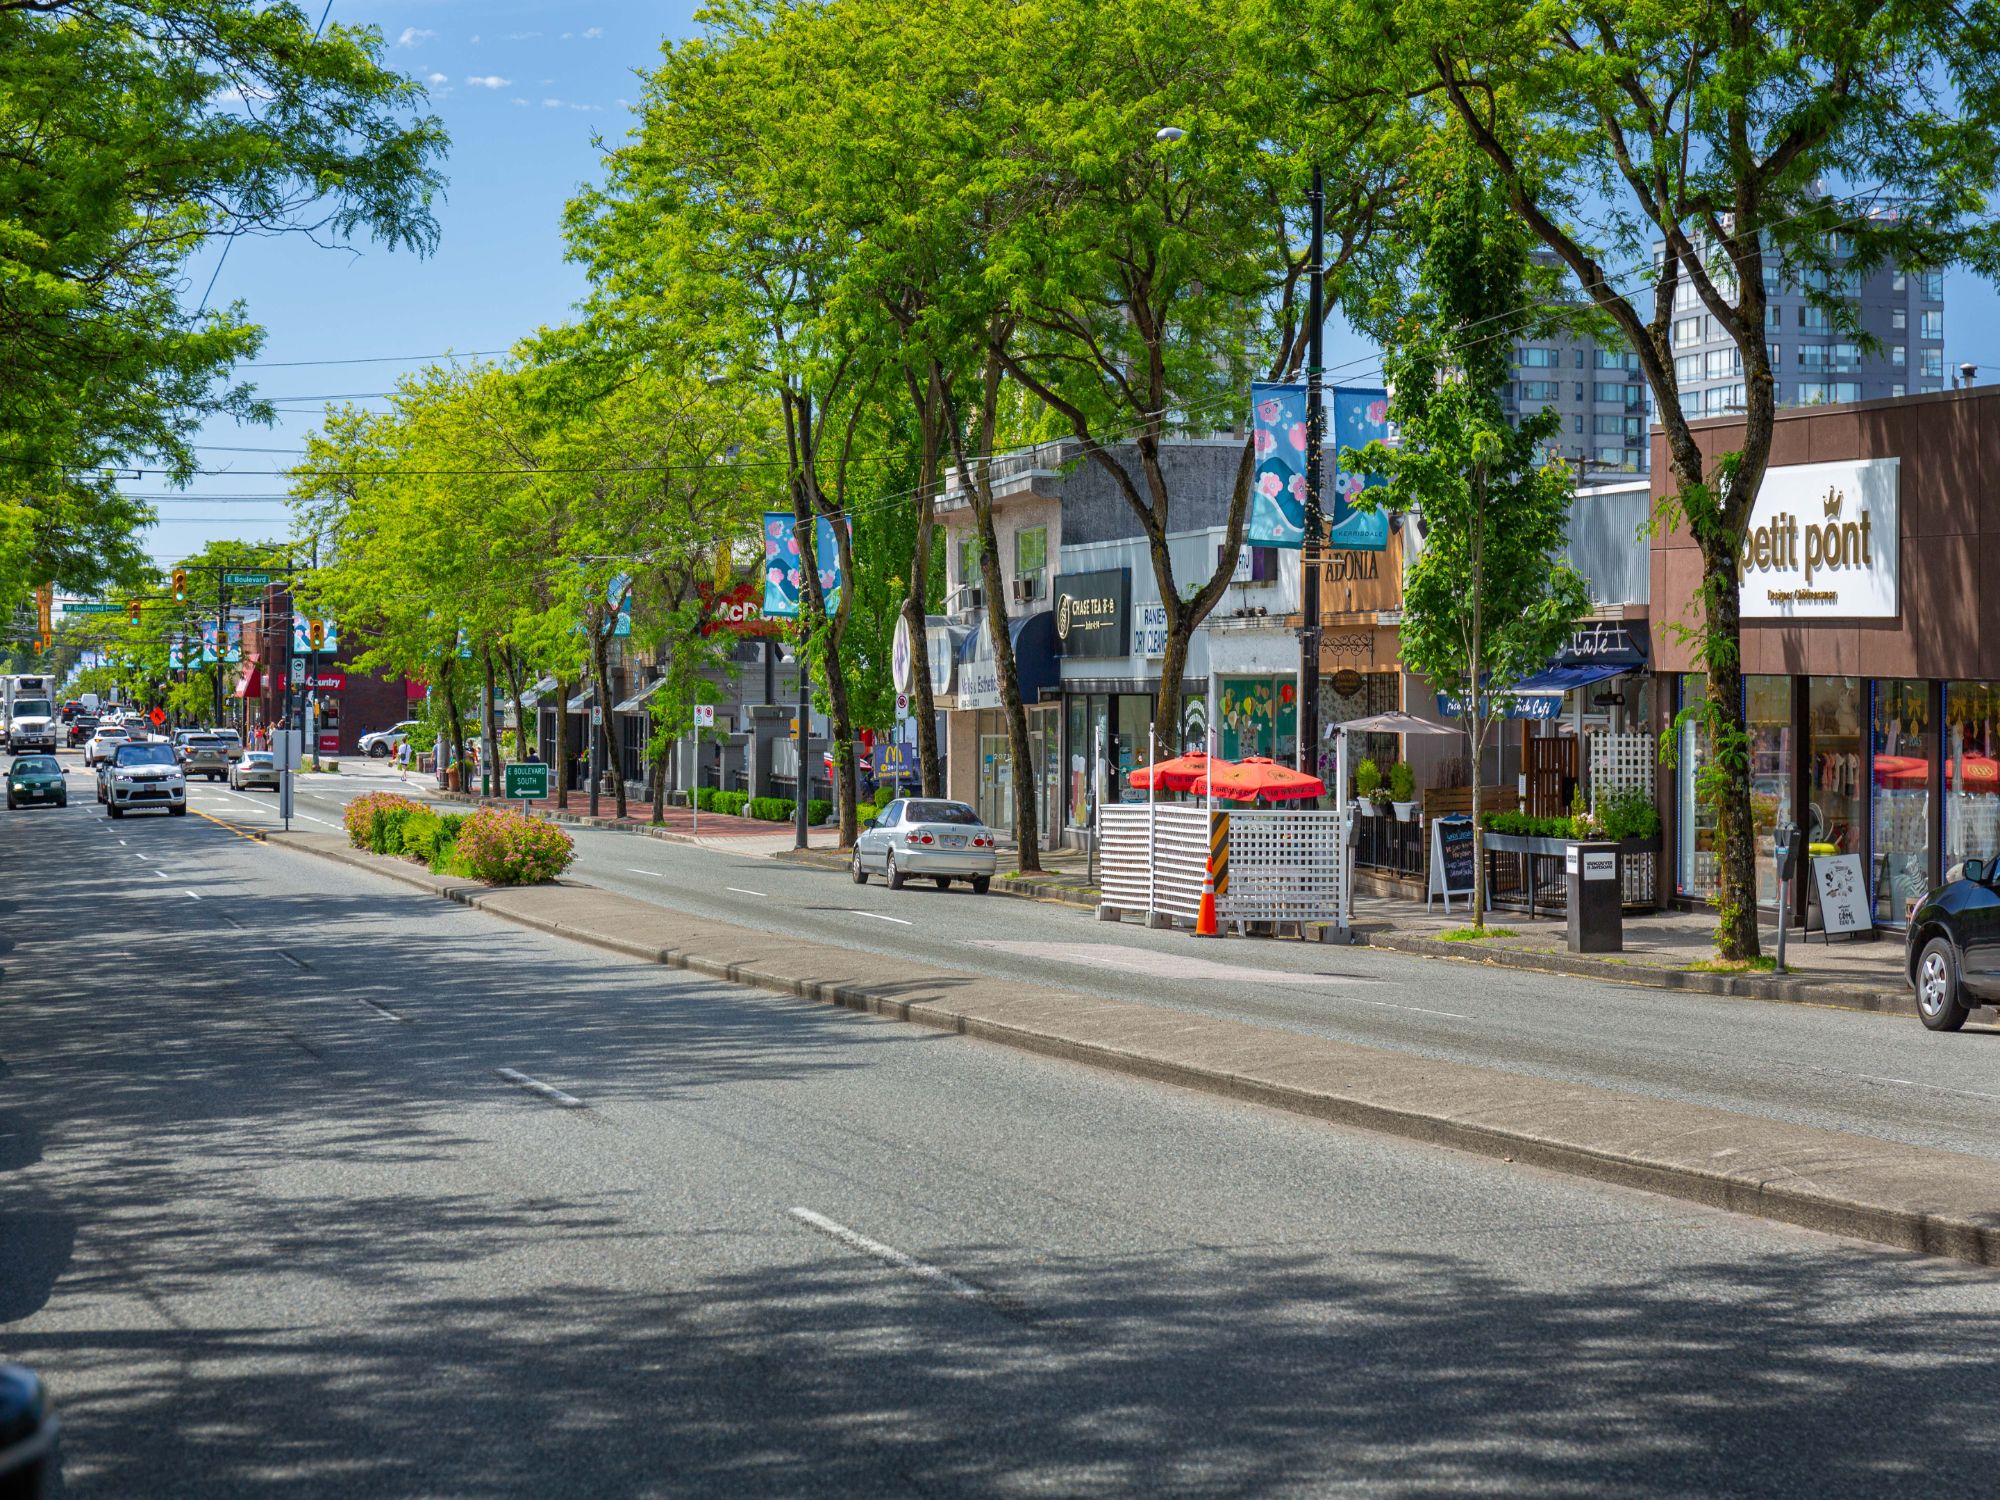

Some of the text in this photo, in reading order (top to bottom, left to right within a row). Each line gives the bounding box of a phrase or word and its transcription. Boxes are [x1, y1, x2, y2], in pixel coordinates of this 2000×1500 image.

[1738, 510, 1871, 582] petit pont
[1325, 551, 1379, 581] ADONIA
[1072, 600, 1090, 616] CHASE
[1091, 599, 1102, 615] TEA
[1147, 630, 1169, 653] CLEANE
[1573, 622, 1609, 657] Café
[517, 777, 537, 785] SOUTH
